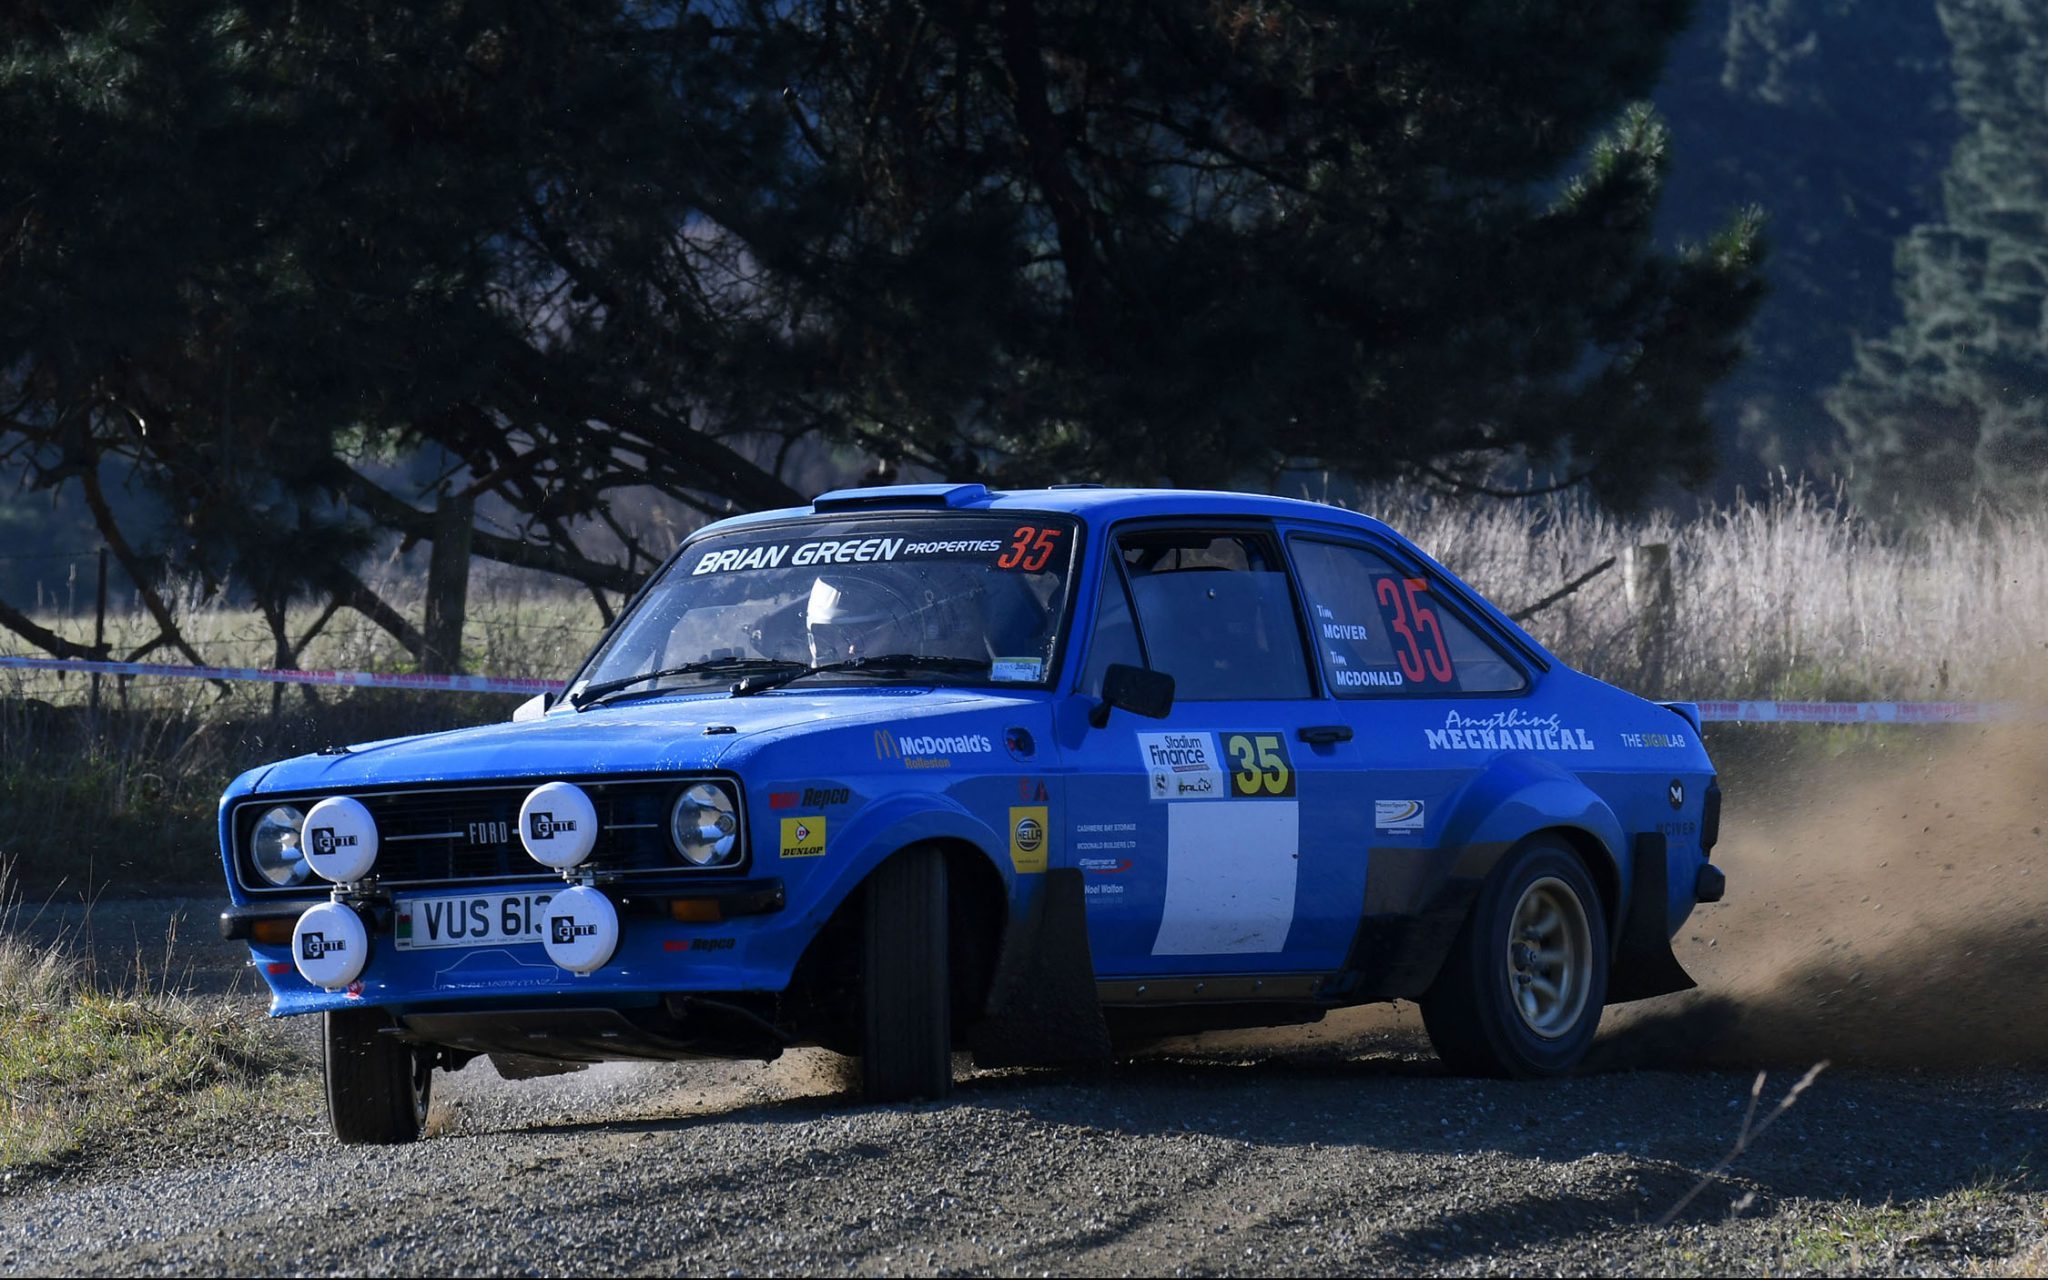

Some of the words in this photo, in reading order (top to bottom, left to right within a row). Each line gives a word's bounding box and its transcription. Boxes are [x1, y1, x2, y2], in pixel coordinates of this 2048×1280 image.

[692, 545, 789, 576] BRIAN
[792, 538, 904, 566] GREEN
[904, 540, 1002, 555] PROPERTIES
[997, 526, 1062, 571] 35
[1317, 605, 1333, 619] Tim
[1323, 624, 1367, 640] MCIVER
[1377, 578, 1452, 682] 35
[1331, 652, 1347, 665] Tim
[1336, 671, 1403, 686] MCDONALD
[1445, 708, 1561, 735] Anything
[900, 735, 991, 755] McDonald's
[1165, 735, 1202, 750] Stadium
[1424, 729, 1595, 750] MECHANICAL
[1149, 744, 1205, 765] Finance
[1229, 735, 1289, 794] 35
[469, 821, 508, 844] FORD
[782, 846, 824, 856] DUNLOP
[424, 900, 489, 941] VUS
